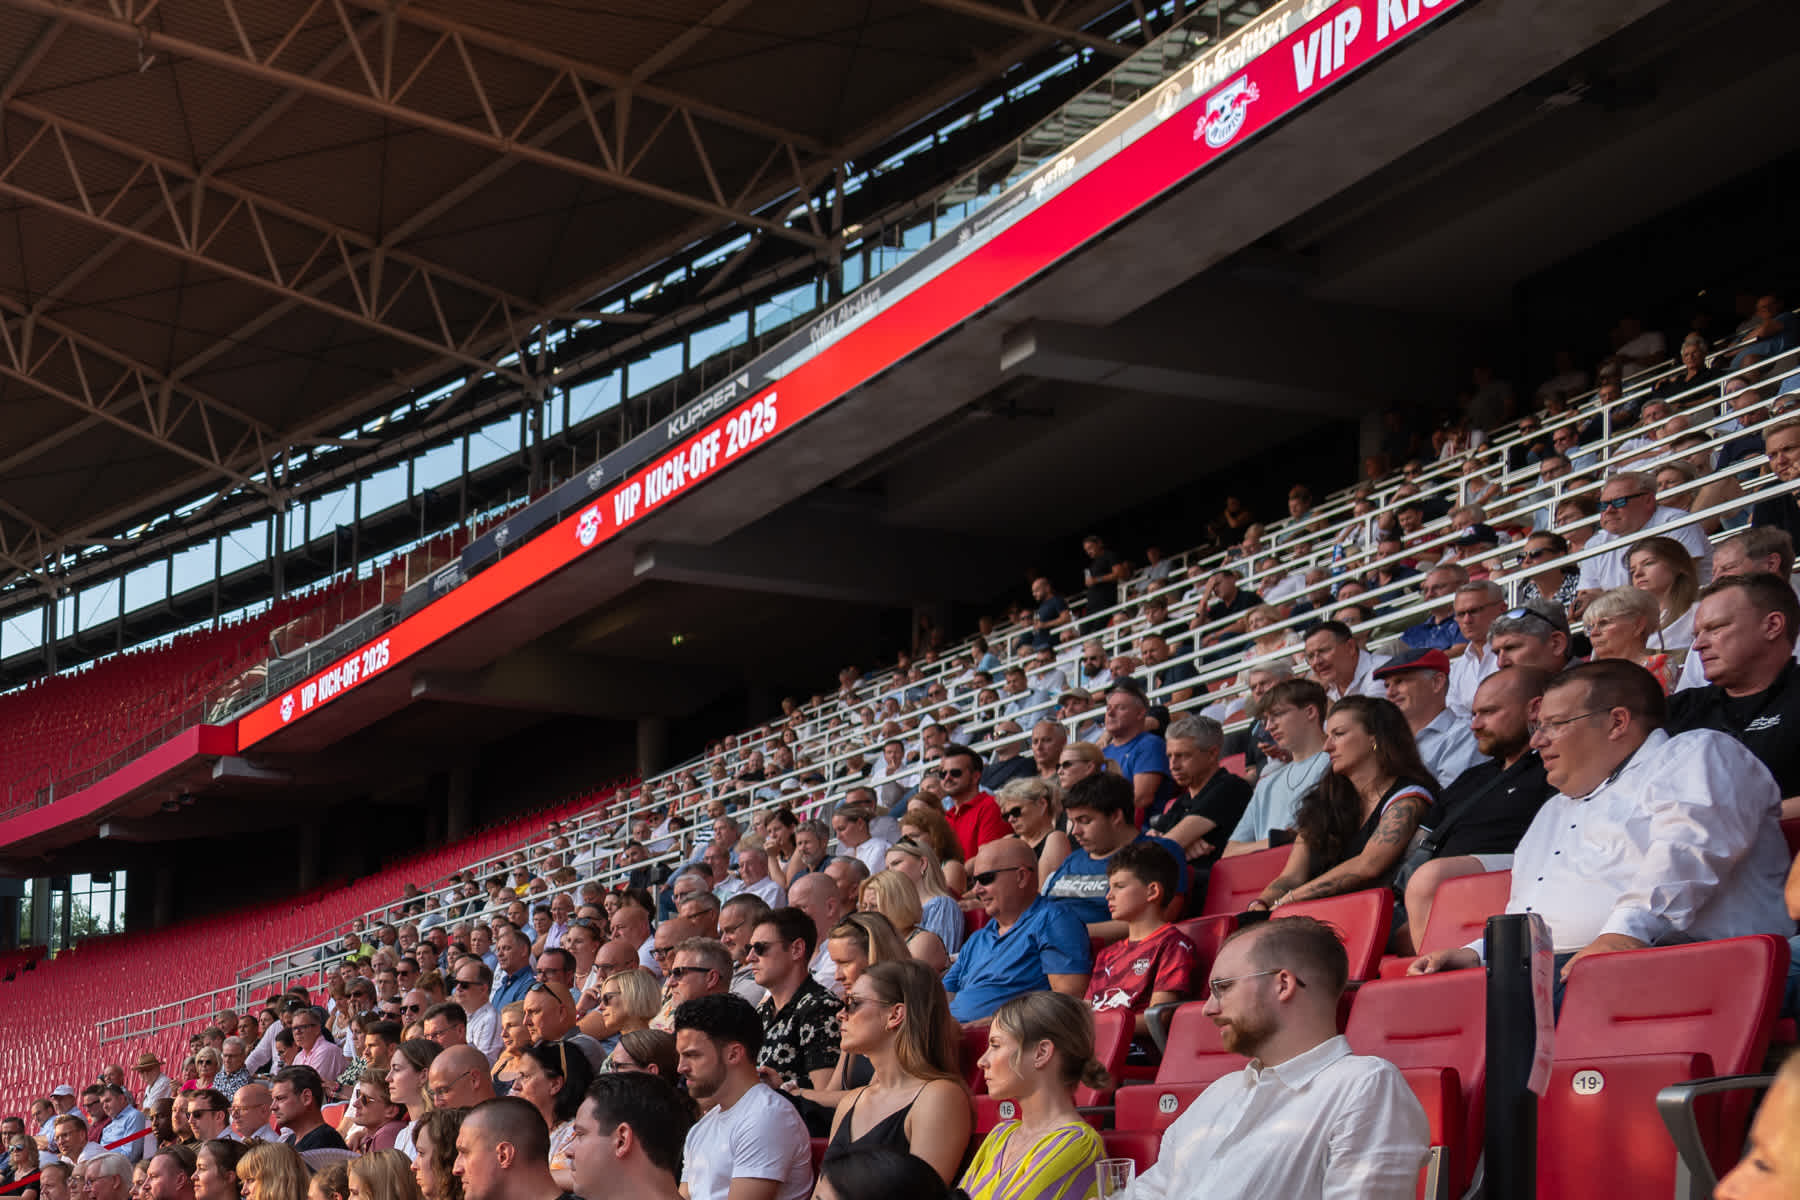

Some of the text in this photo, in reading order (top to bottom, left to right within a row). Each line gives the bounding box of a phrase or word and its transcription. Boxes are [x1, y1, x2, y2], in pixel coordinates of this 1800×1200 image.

[1292, 6, 1363, 94] VIP
[613, 392, 778, 526] VIP KICK-OFF 2025
[301, 638, 390, 712] VIP KICK-OFF 2025
